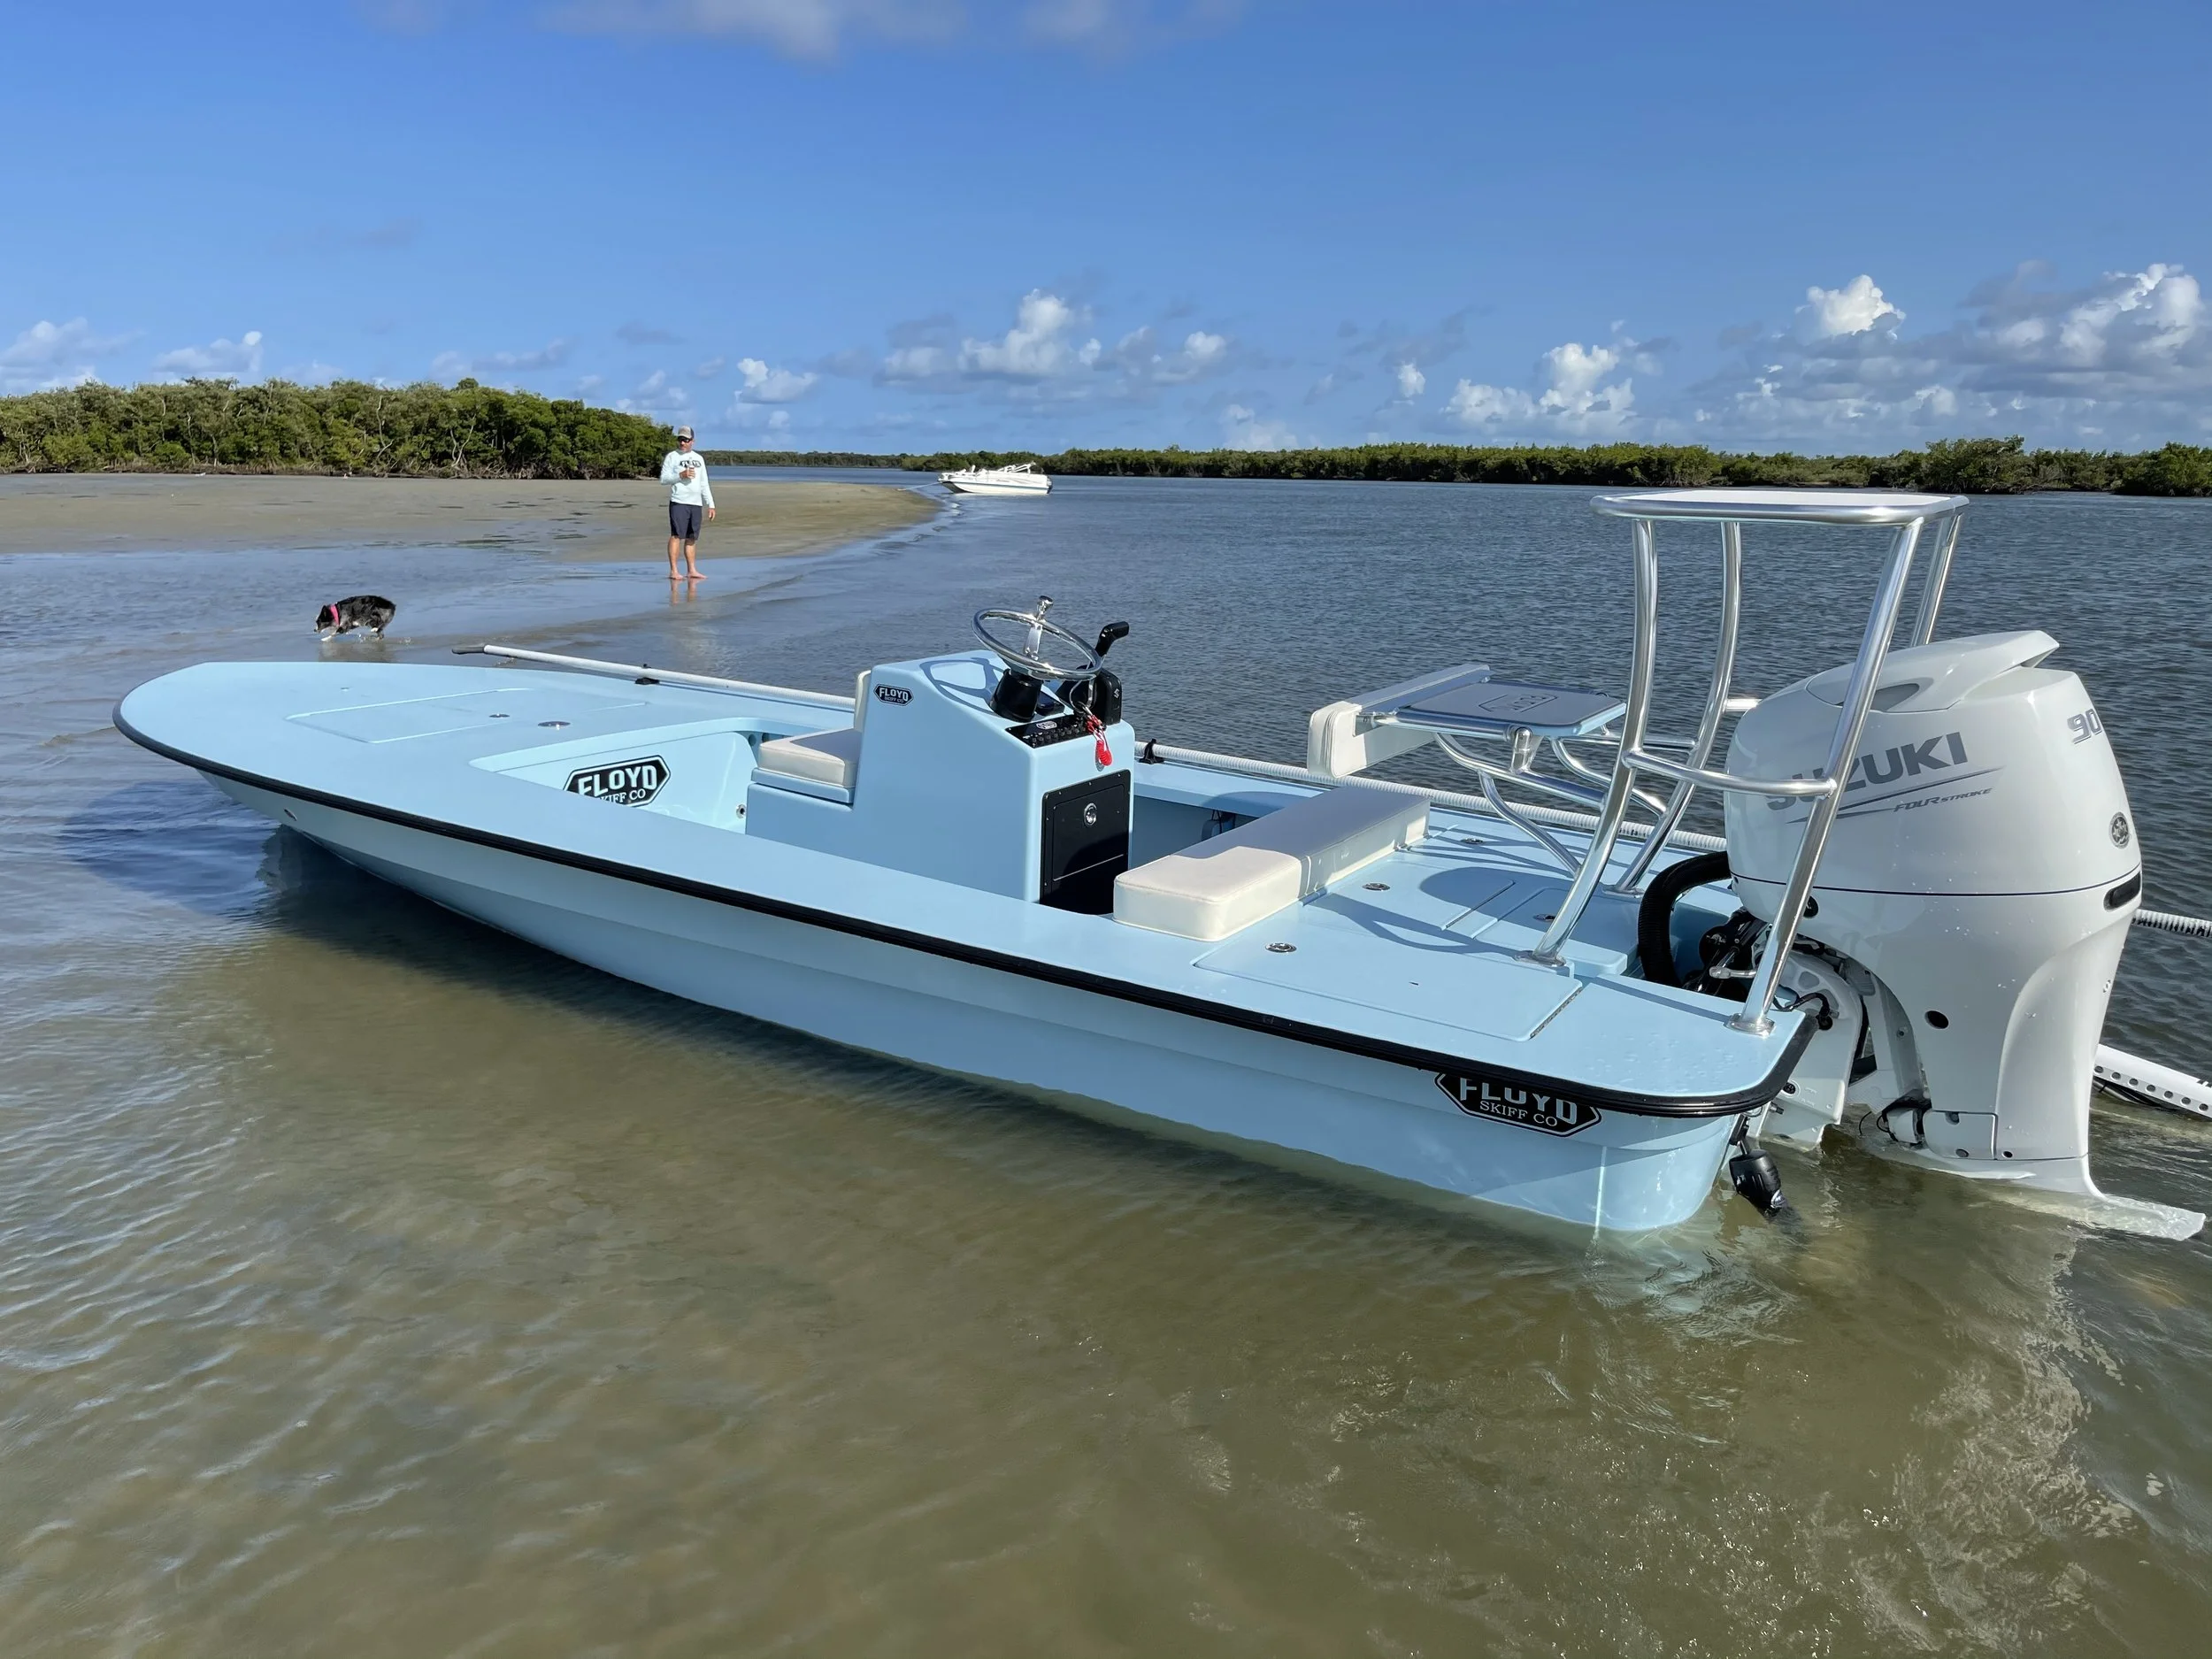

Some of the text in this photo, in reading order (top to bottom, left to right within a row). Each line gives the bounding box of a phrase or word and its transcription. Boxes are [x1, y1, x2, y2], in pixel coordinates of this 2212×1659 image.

[879, 687, 909, 702] FLOYD
[2067, 708, 2102, 744] 90
[578, 764, 657, 796] FLOYD
[1766, 732, 1969, 810] UKI
[601, 788, 646, 803] IFF CO
[1460, 1077, 1578, 1125] FLOYD
[1479, 1100, 1558, 1127] SKIFF CO
